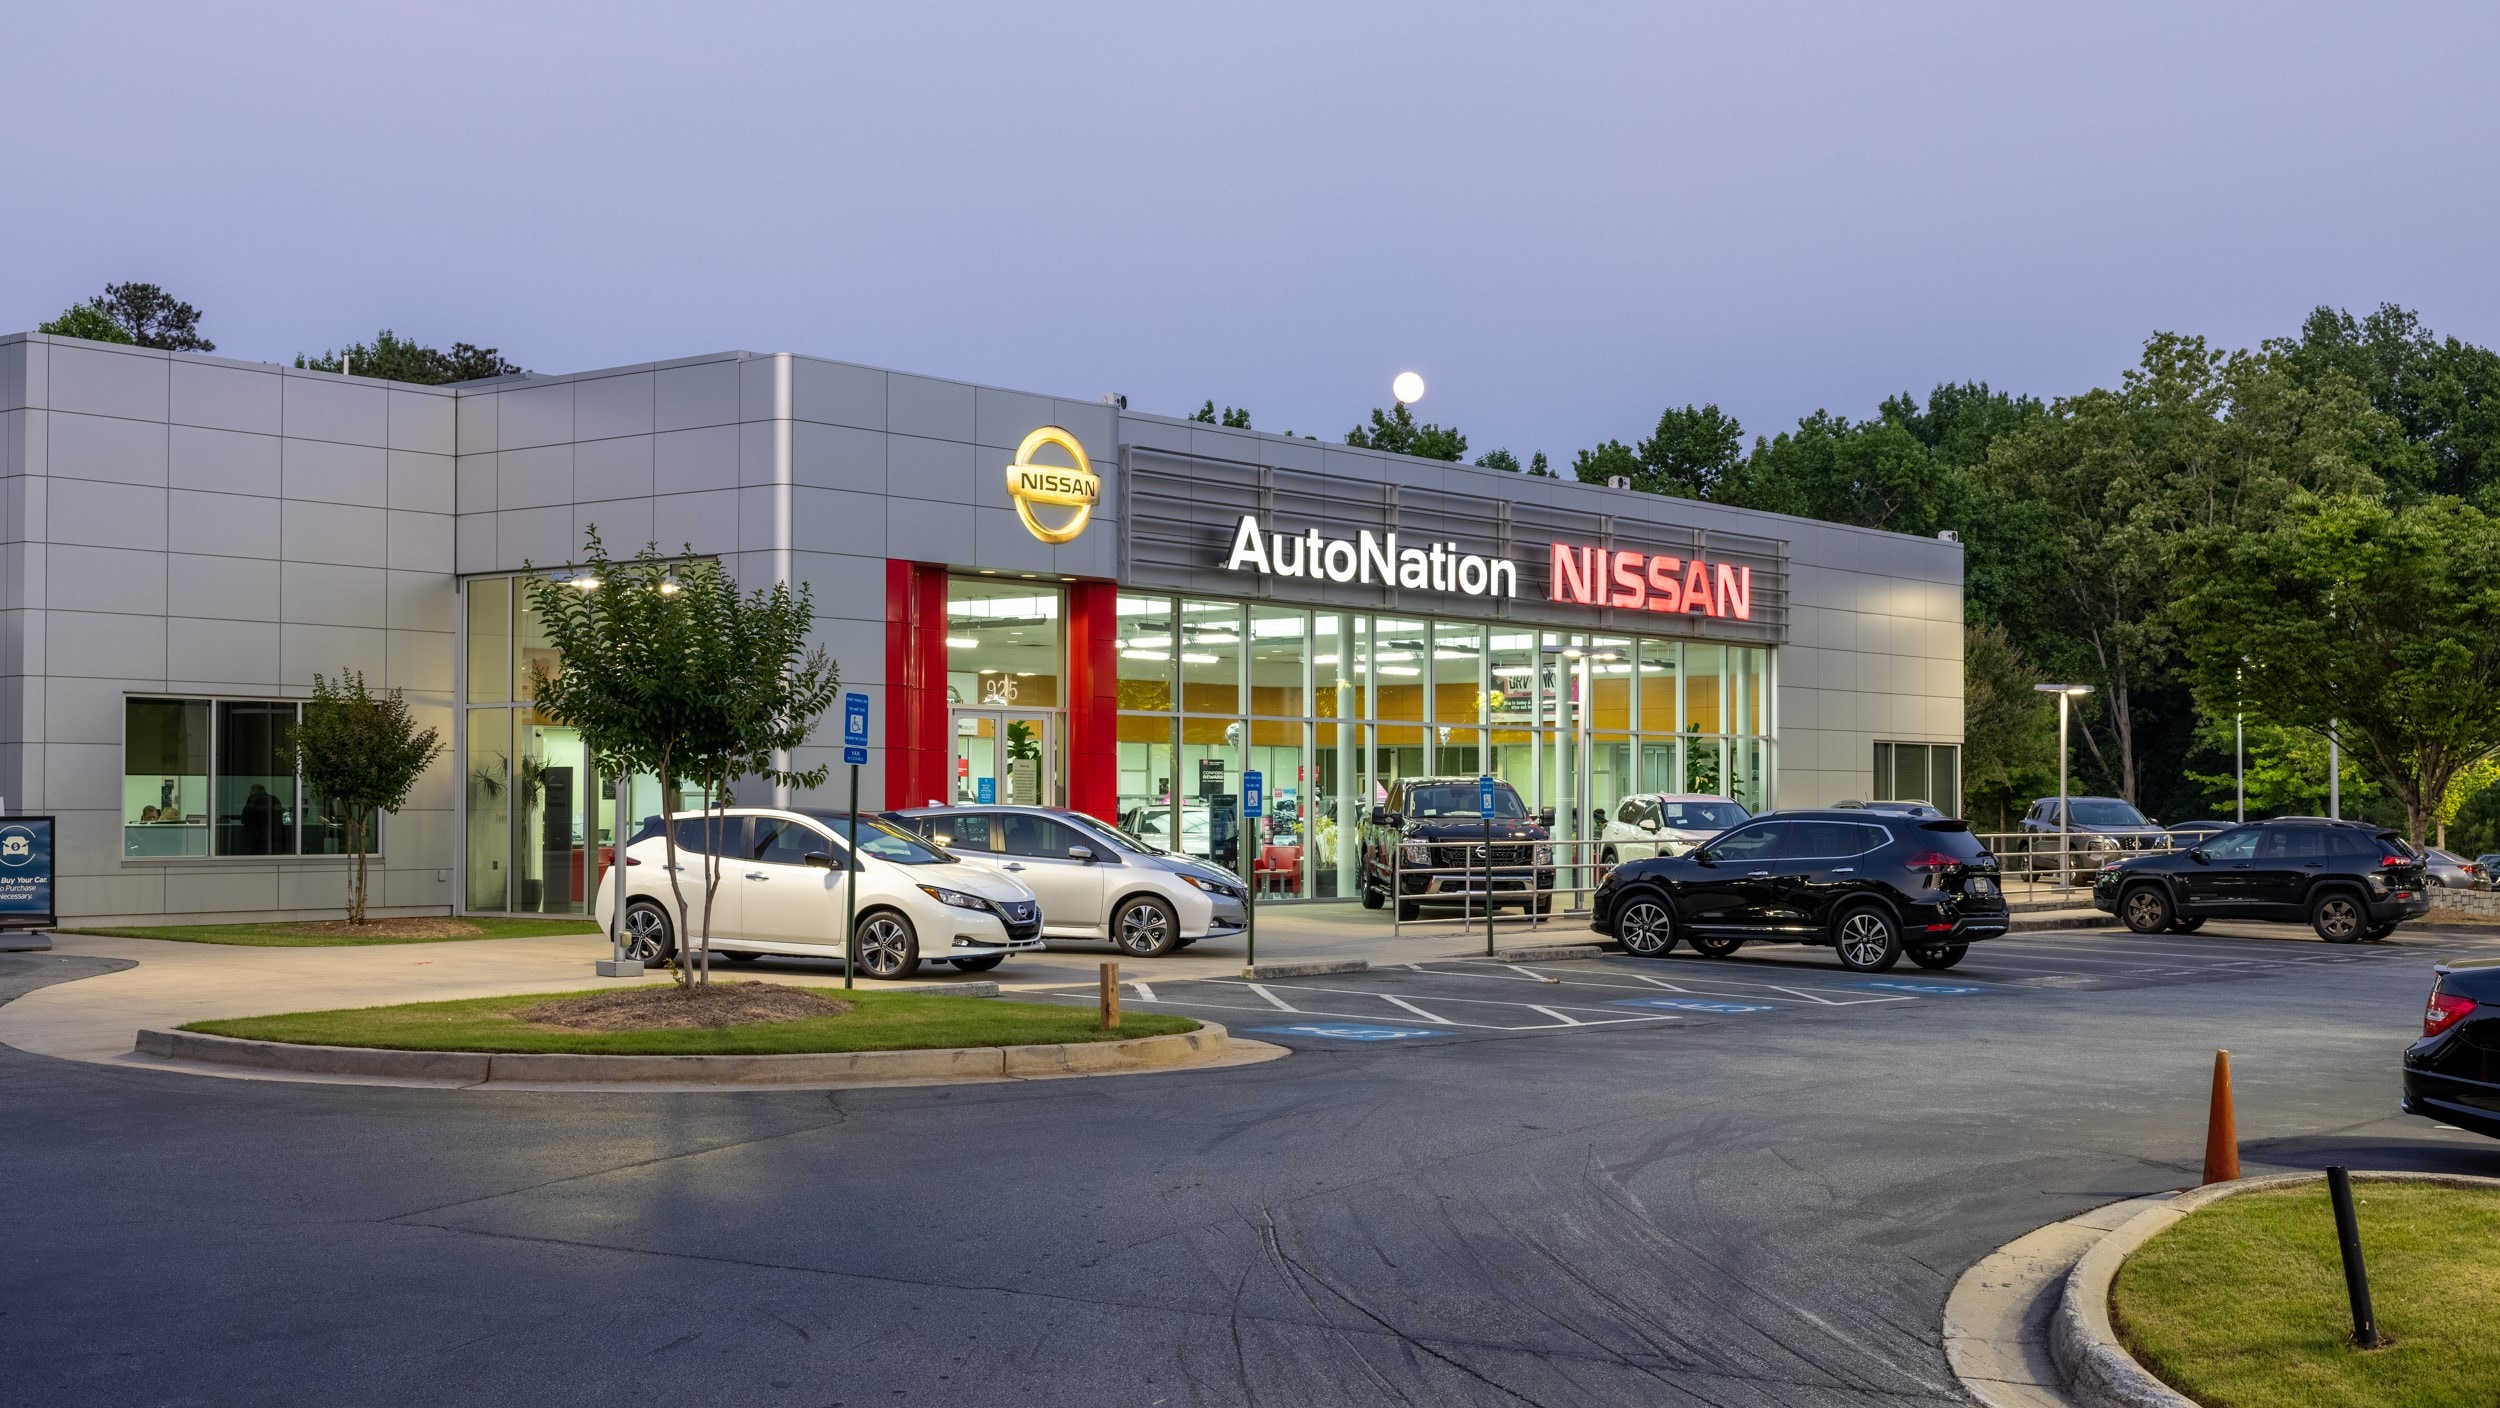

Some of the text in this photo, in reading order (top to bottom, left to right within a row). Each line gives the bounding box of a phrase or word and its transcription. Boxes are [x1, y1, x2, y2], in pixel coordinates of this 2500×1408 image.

[1021, 472, 1096, 497] NISSAN
[1227, 515, 1751, 620] AutoNation NISSAN
[986, 679, 1018, 699] 925
